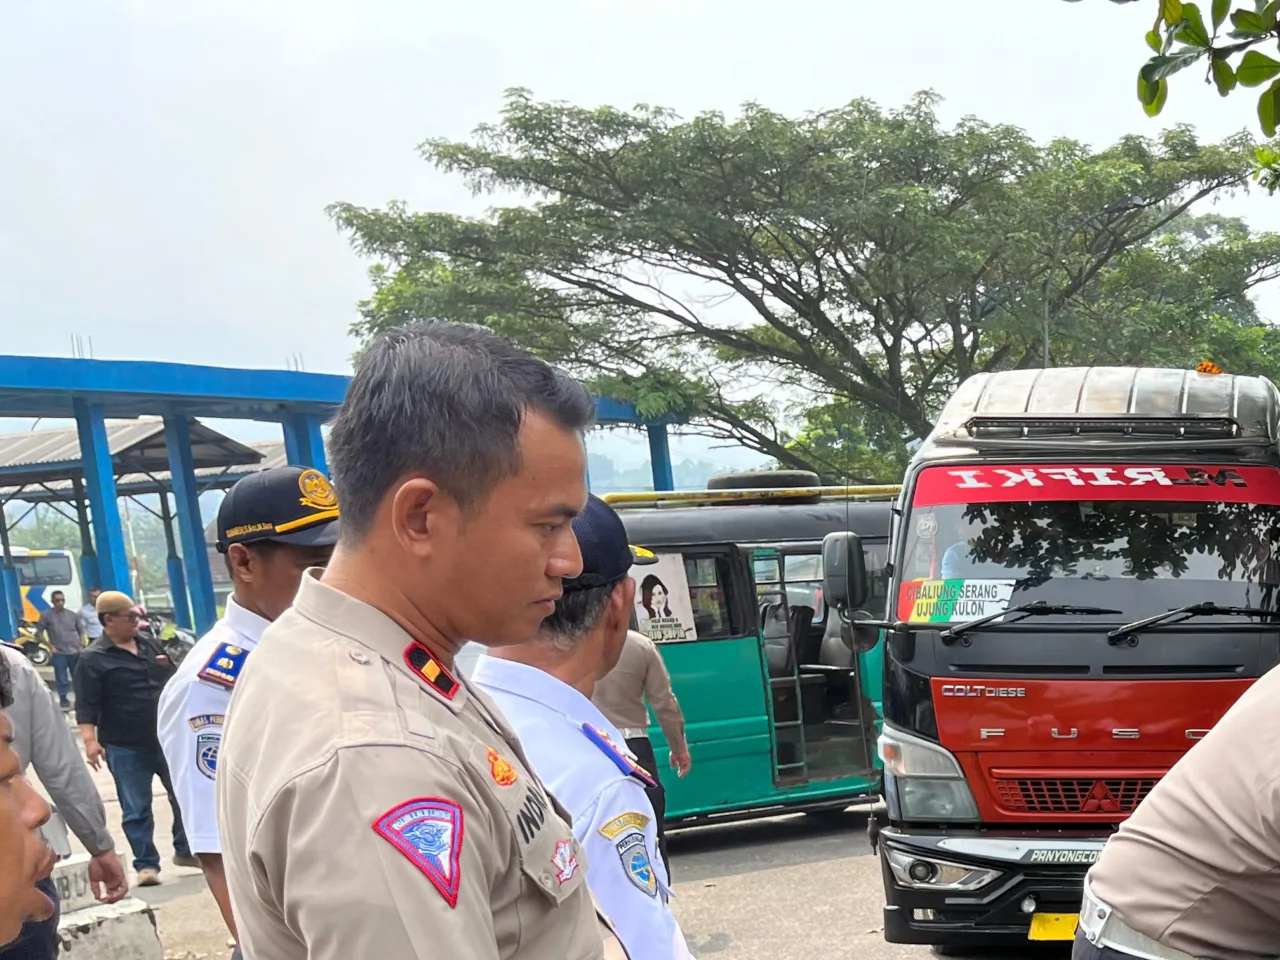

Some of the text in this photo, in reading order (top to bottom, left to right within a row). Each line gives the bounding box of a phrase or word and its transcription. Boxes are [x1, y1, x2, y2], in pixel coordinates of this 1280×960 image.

[906, 584, 998, 600] CIBALIUNG SERANG
[916, 600, 985, 617] UJUNG KULON
